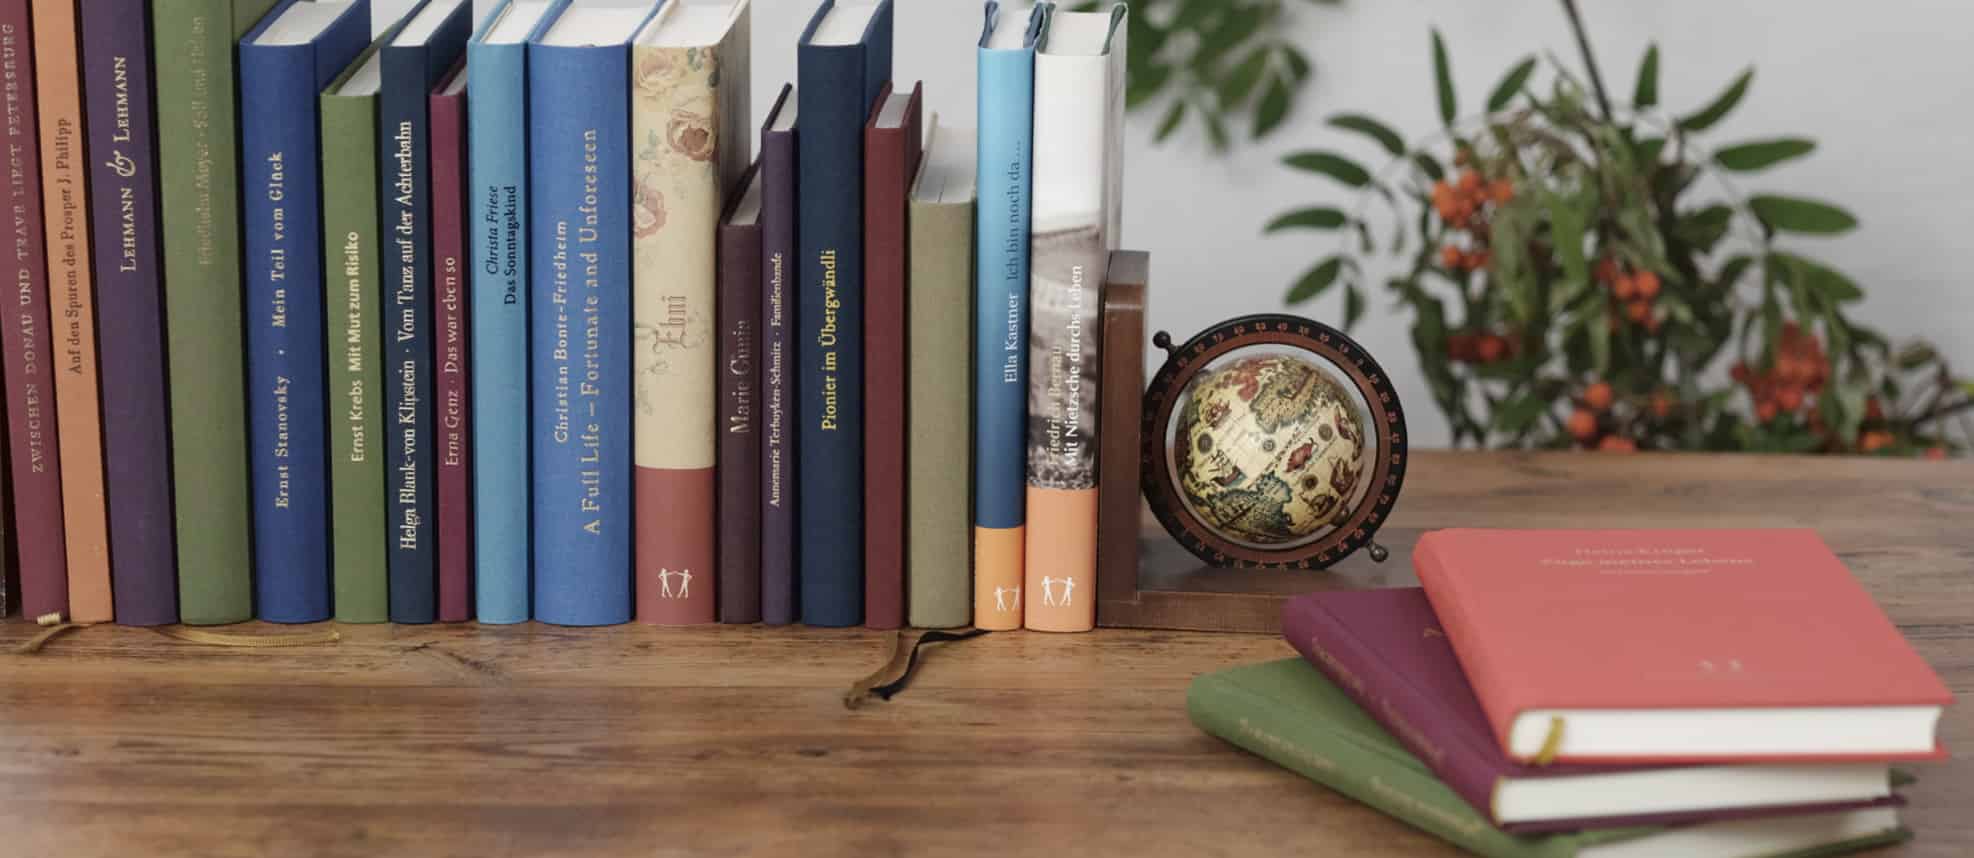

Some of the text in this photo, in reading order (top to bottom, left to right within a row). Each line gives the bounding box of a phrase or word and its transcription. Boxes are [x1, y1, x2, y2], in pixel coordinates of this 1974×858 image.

[2, 24, 22, 136] PETERSBURG
[55, 119, 72, 169] Philipp
[105, 150, 135, 177] &
[10, 144, 25, 196] LIEGT
[579, 129, 598, 242] Unforeseen
[1006, 161, 1020, 180] da
[60, 189, 77, 240] Prosper
[1006, 186, 1020, 223] noch
[62, 244, 76, 266] des
[486, 186, 500, 275] Christa Friese
[503, 186, 521, 305] Das Sonntagskind
[1005, 229, 1020, 253] bin
[18, 269, 32, 306] UND
[64, 270, 82, 318] Spuren
[580, 252, 598, 287] and
[1005, 258, 1019, 280] Ich
[21, 313, 37, 374] DONAU
[66, 321, 80, 346] den
[267, 152, 292, 508] Ernst Stanovsky Mein Teil vom Glück
[344, 232, 363, 462] Ernst Krebs Mit Mut zum Risiko
[396, 121, 420, 550] Helga Blank-von Klipstein Vom Tanz auf der Achterbahn
[553, 221, 569, 442] Christian Bonte-Friedheim
[580, 296, 599, 396] Fortunate
[818, 250, 840, 430] Pionier im Übergwändli
[1004, 293, 1019, 350] Kastner
[67, 349, 81, 375] Auf
[443, 257, 460, 466] Erna Genz Das war eben so
[1004, 355, 1018, 383] Ella
[1065, 266, 1082, 466] Mit Nietzsche durchs Leben
[27, 384, 44, 472] ZWISCHEN
[730, 382, 750, 432] Marie
[580, 424, 599, 462] Life
[1046, 402, 1061, 465] Friedrich
[580, 470, 600, 511] Full
[770, 449, 781, 507] Annemarie
[583, 520, 600, 534] A
